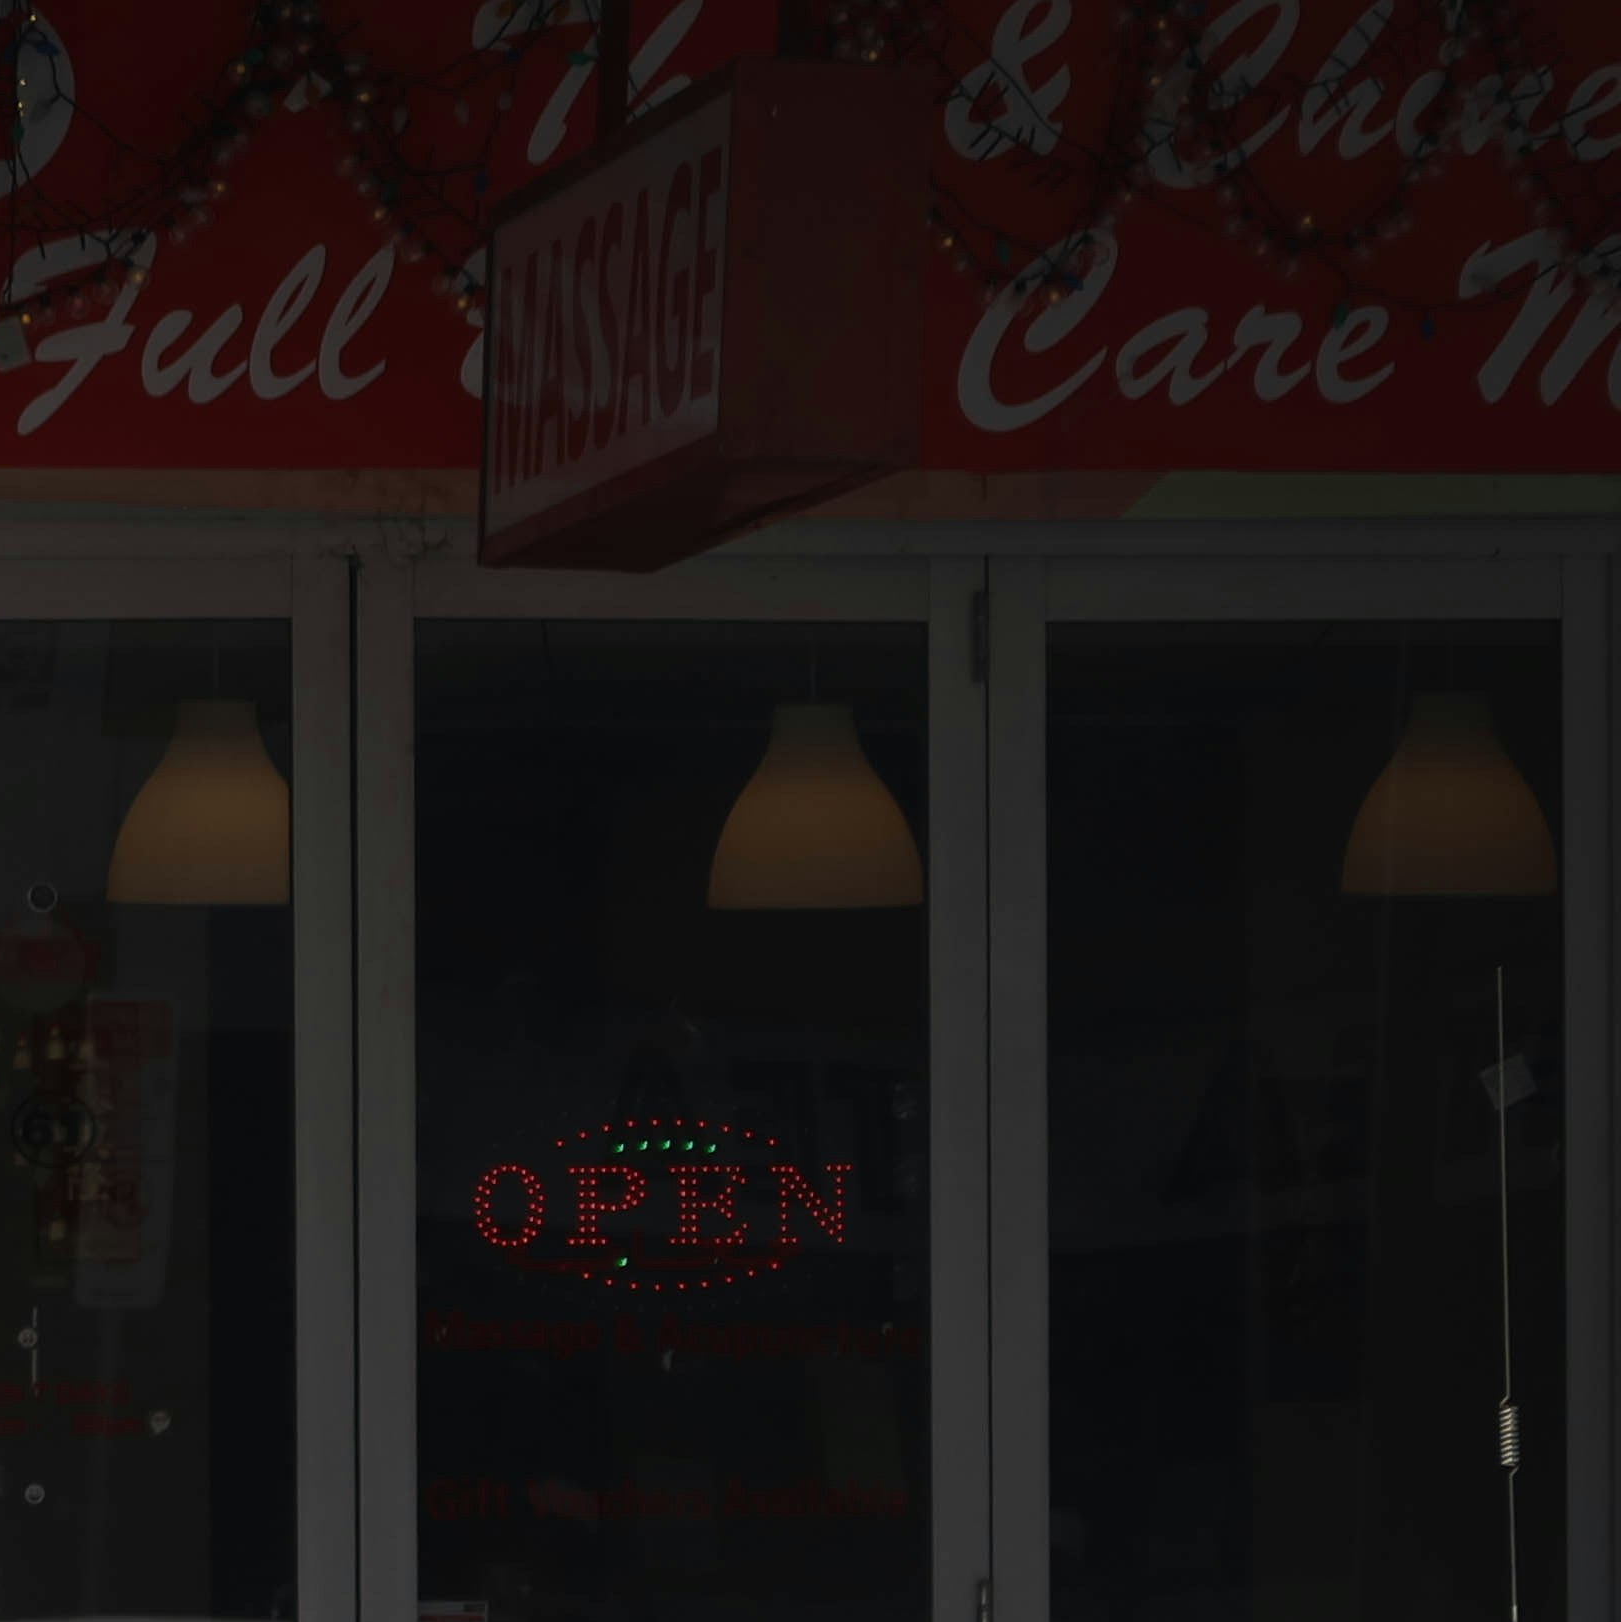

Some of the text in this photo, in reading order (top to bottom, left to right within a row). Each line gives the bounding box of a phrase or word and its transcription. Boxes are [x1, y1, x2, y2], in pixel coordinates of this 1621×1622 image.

[1, 226, 397, 437] Full
[493, 144, 724, 497] MASSAGE
[956, 227, 1396, 433] Care
[472, 1162, 853, 1248] OPEN
